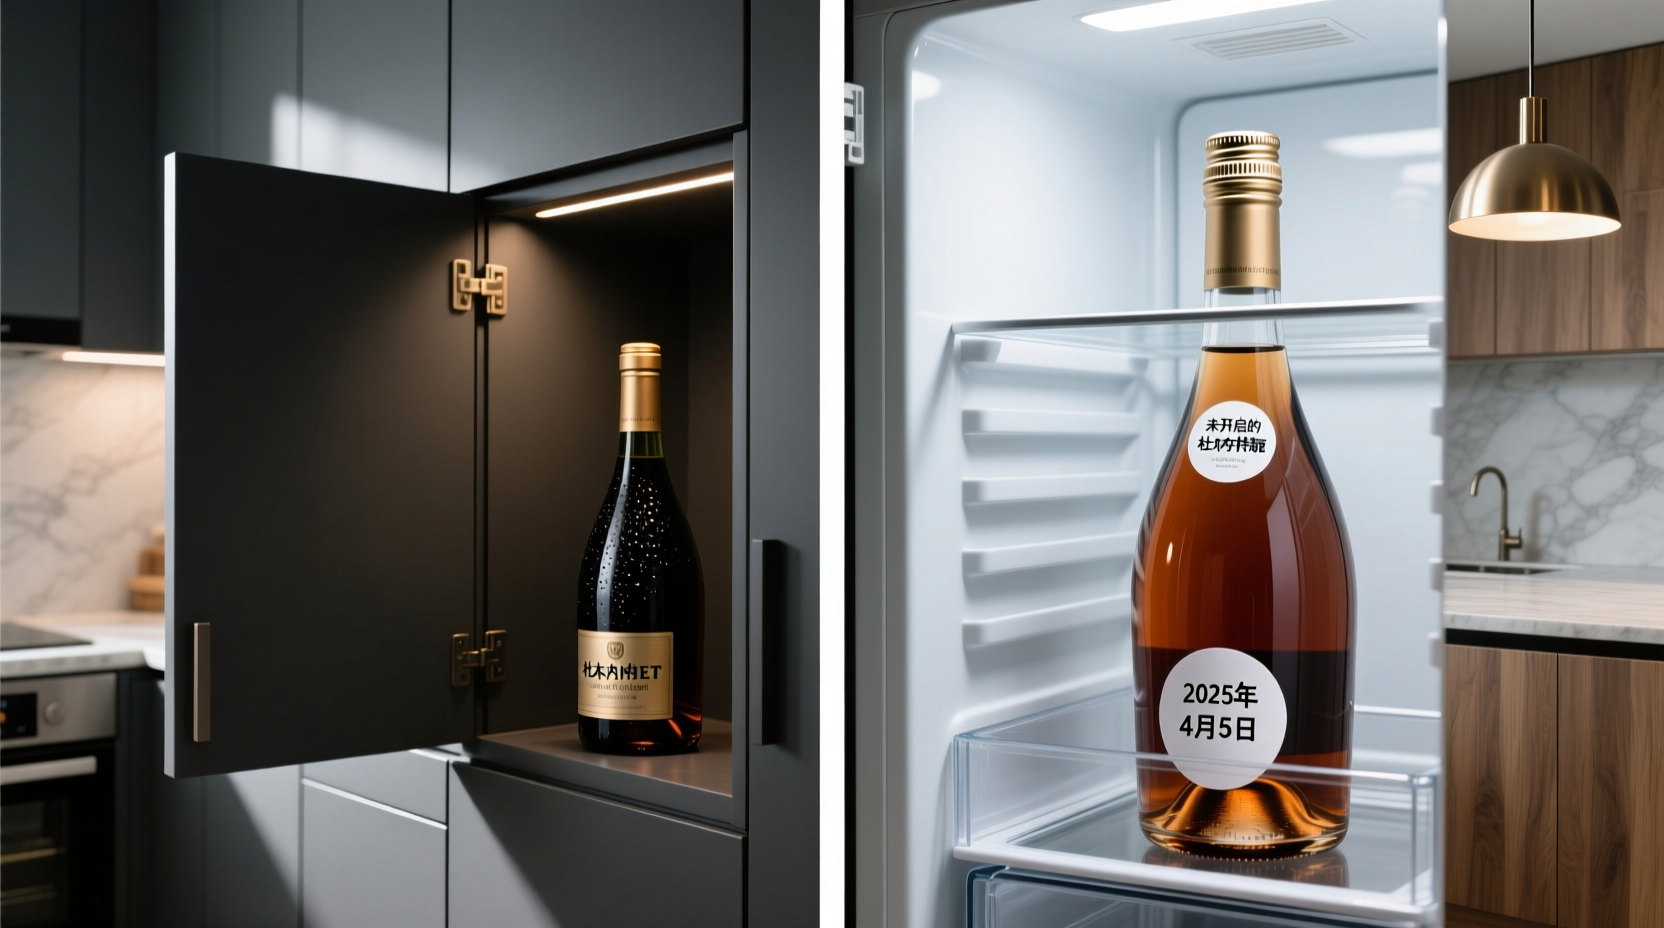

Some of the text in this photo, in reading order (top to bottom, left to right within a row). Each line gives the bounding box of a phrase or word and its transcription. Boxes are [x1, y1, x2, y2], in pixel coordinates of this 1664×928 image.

[1205, 416, 1262, 433] 未开启的
[1183, 681, 1258, 709] 2025年
[1179, 714, 1255, 742] 4月5日
